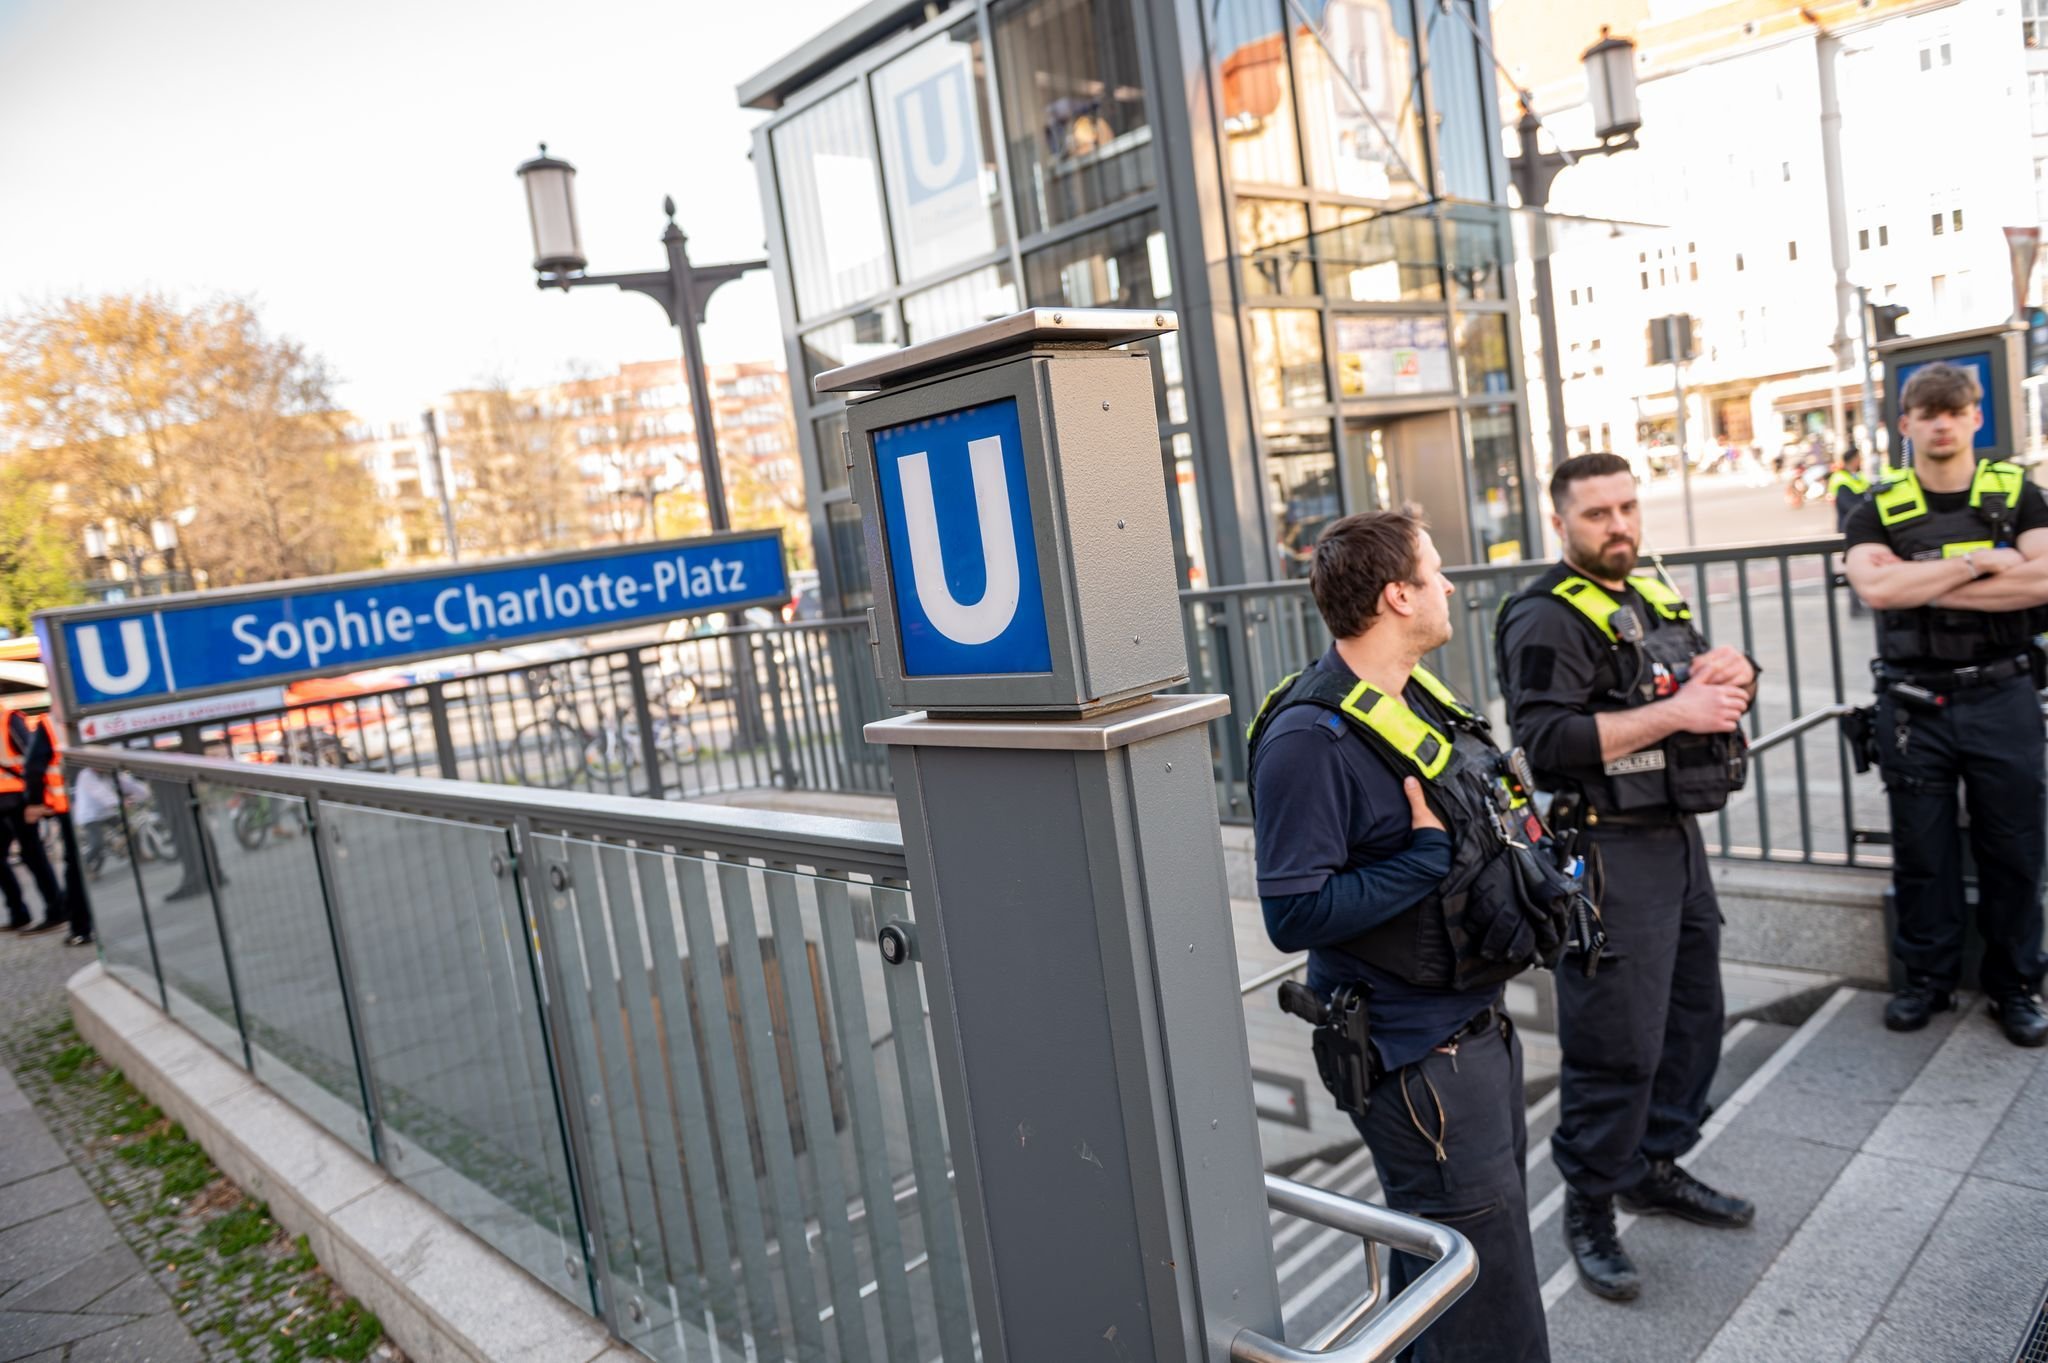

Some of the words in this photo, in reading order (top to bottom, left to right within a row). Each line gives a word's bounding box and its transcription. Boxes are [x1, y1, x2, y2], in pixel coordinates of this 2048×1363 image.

[903, 71, 966, 191] U
[897, 434, 1020, 646] U
[75, 619, 151, 695] U
[231, 556, 747, 668] Sophie-Charlotte-Platz
